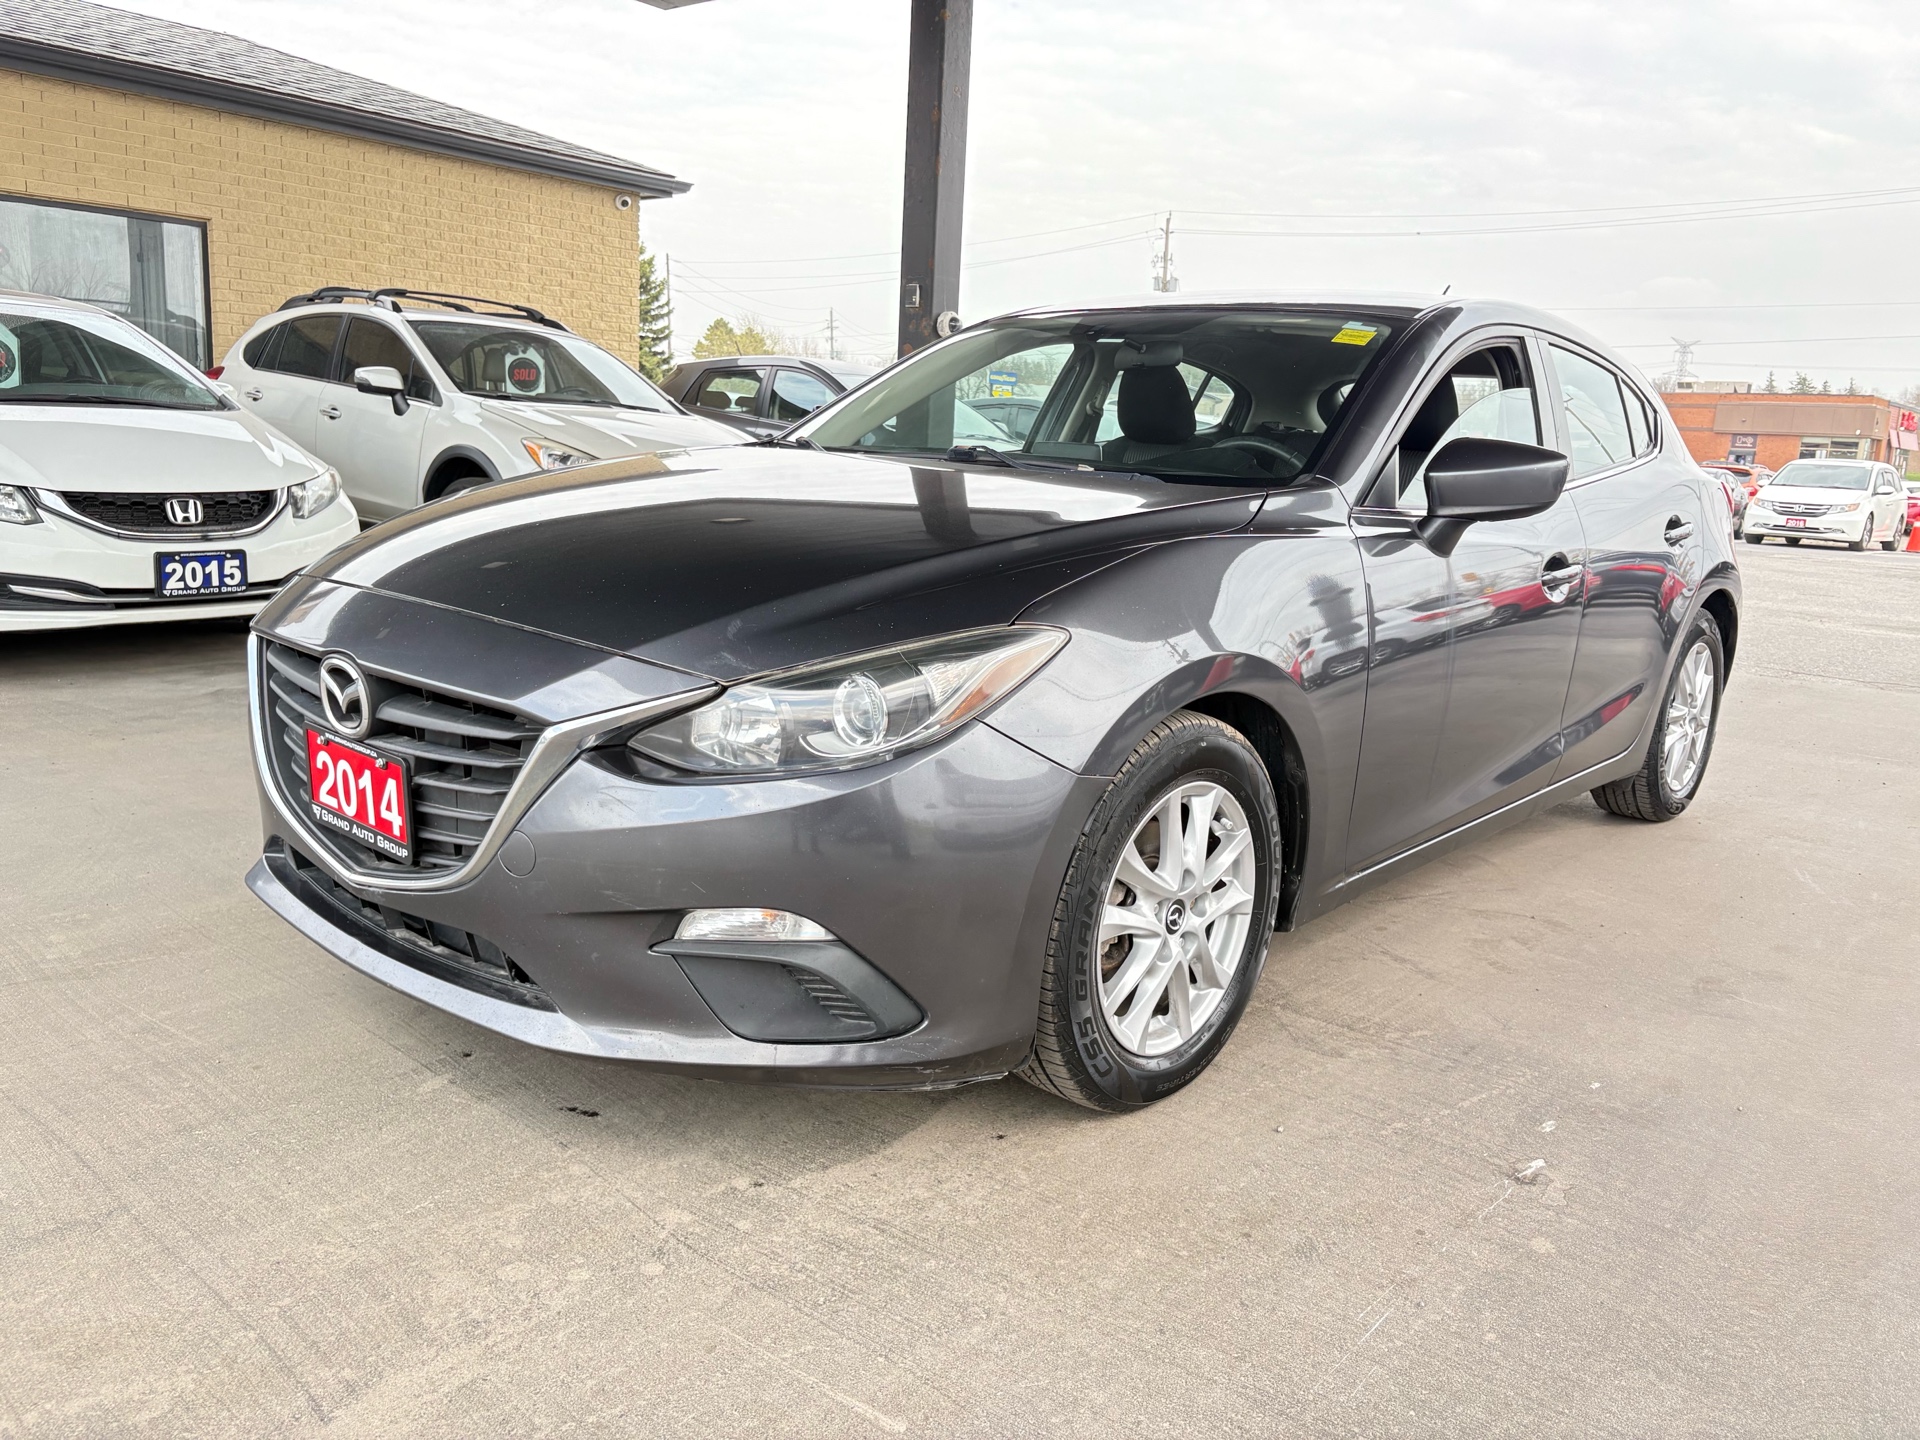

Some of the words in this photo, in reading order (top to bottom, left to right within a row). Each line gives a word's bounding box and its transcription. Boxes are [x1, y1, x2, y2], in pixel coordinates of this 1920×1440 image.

[513, 368, 537, 381] SOLD
[164, 559, 242, 590] 2015
[316, 750, 403, 838] 2014
[321, 809, 350, 832] GRAND
[352, 823, 375, 844] AUTO
[376, 835, 409, 859] GROUP
[1074, 862, 1106, 1002] GRAND
[1076, 1015, 1114, 1079] CS5
